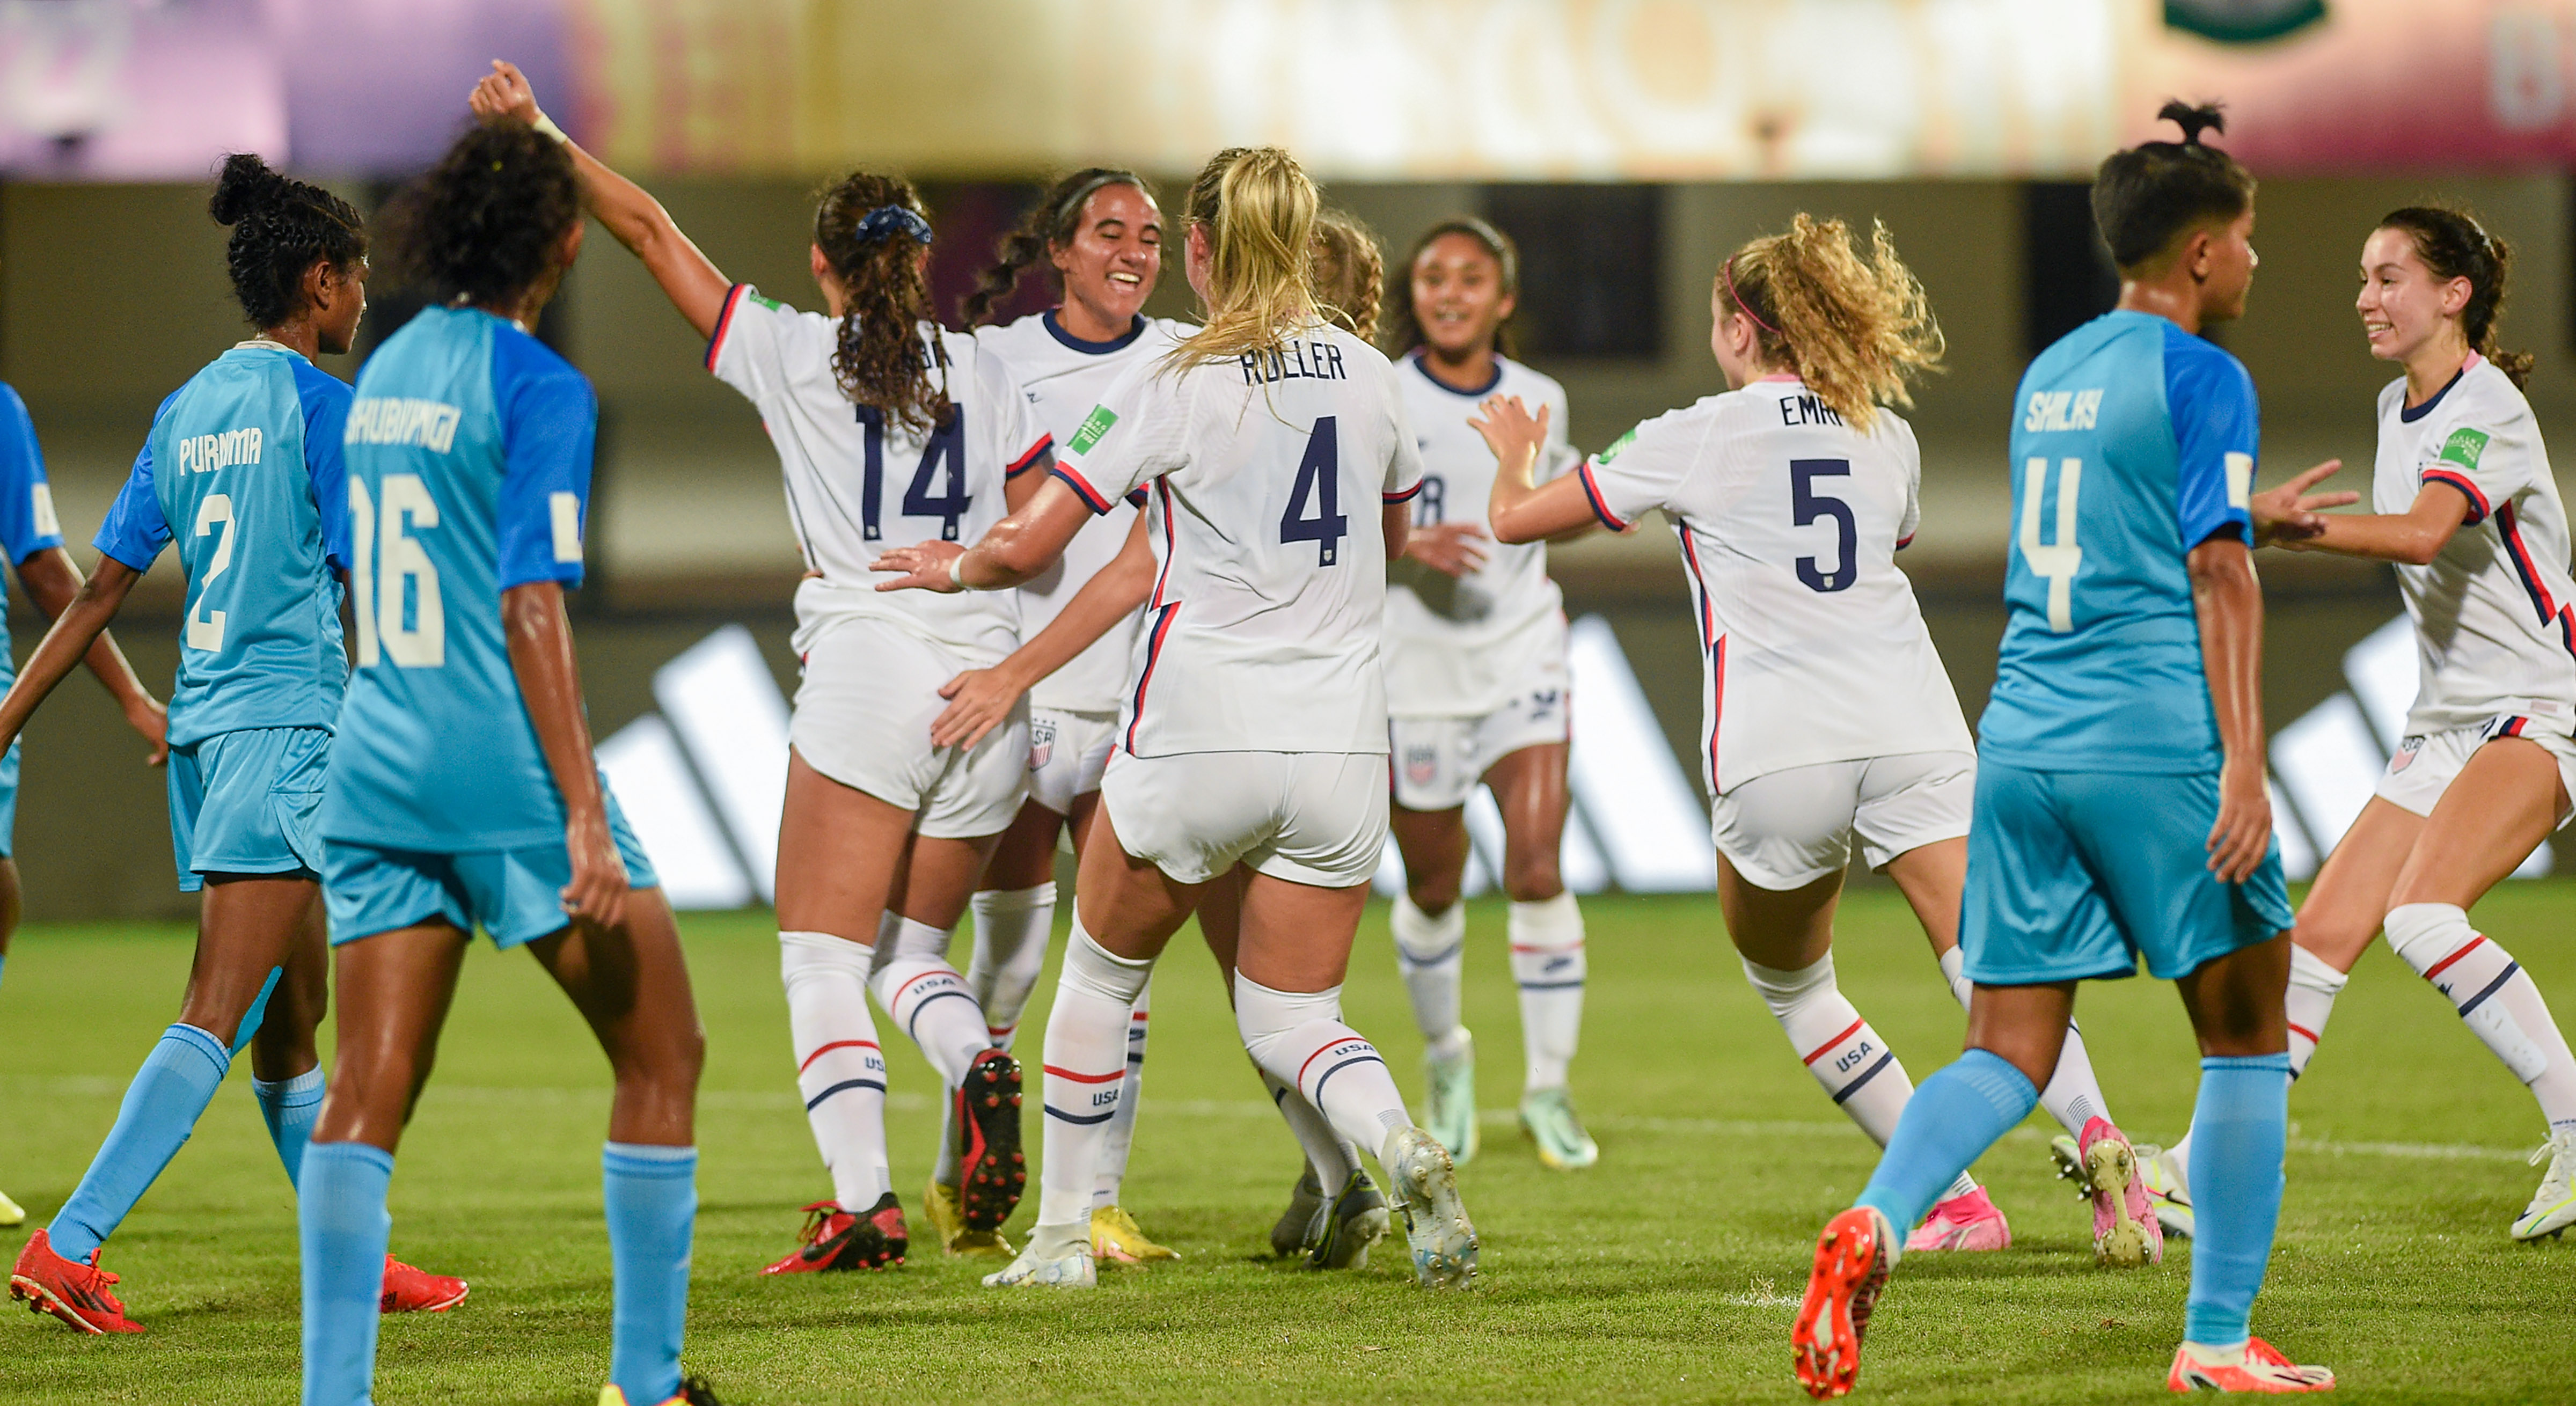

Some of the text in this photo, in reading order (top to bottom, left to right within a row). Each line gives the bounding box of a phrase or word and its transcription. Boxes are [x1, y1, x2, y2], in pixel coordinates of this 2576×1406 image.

[1240, 340, 1347, 386] ROLLER
[179, 428, 263, 477] PURNIMA
[855, 402, 973, 540] 14
[1280, 415, 1347, 567] 4
[1790, 459, 1857, 592] 5
[2019, 457, 2083, 633] 4
[187, 494, 236, 653] 2
[348, 473, 445, 668] 16
[1034, 730, 1053, 745] SA
[913, 978, 956, 994] USA
[865, 1056, 885, 1072] US
[1334, 1044, 1375, 1056] USA
[1836, 1042, 1873, 1072] USA
[1093, 1088, 1119, 1106] USA
